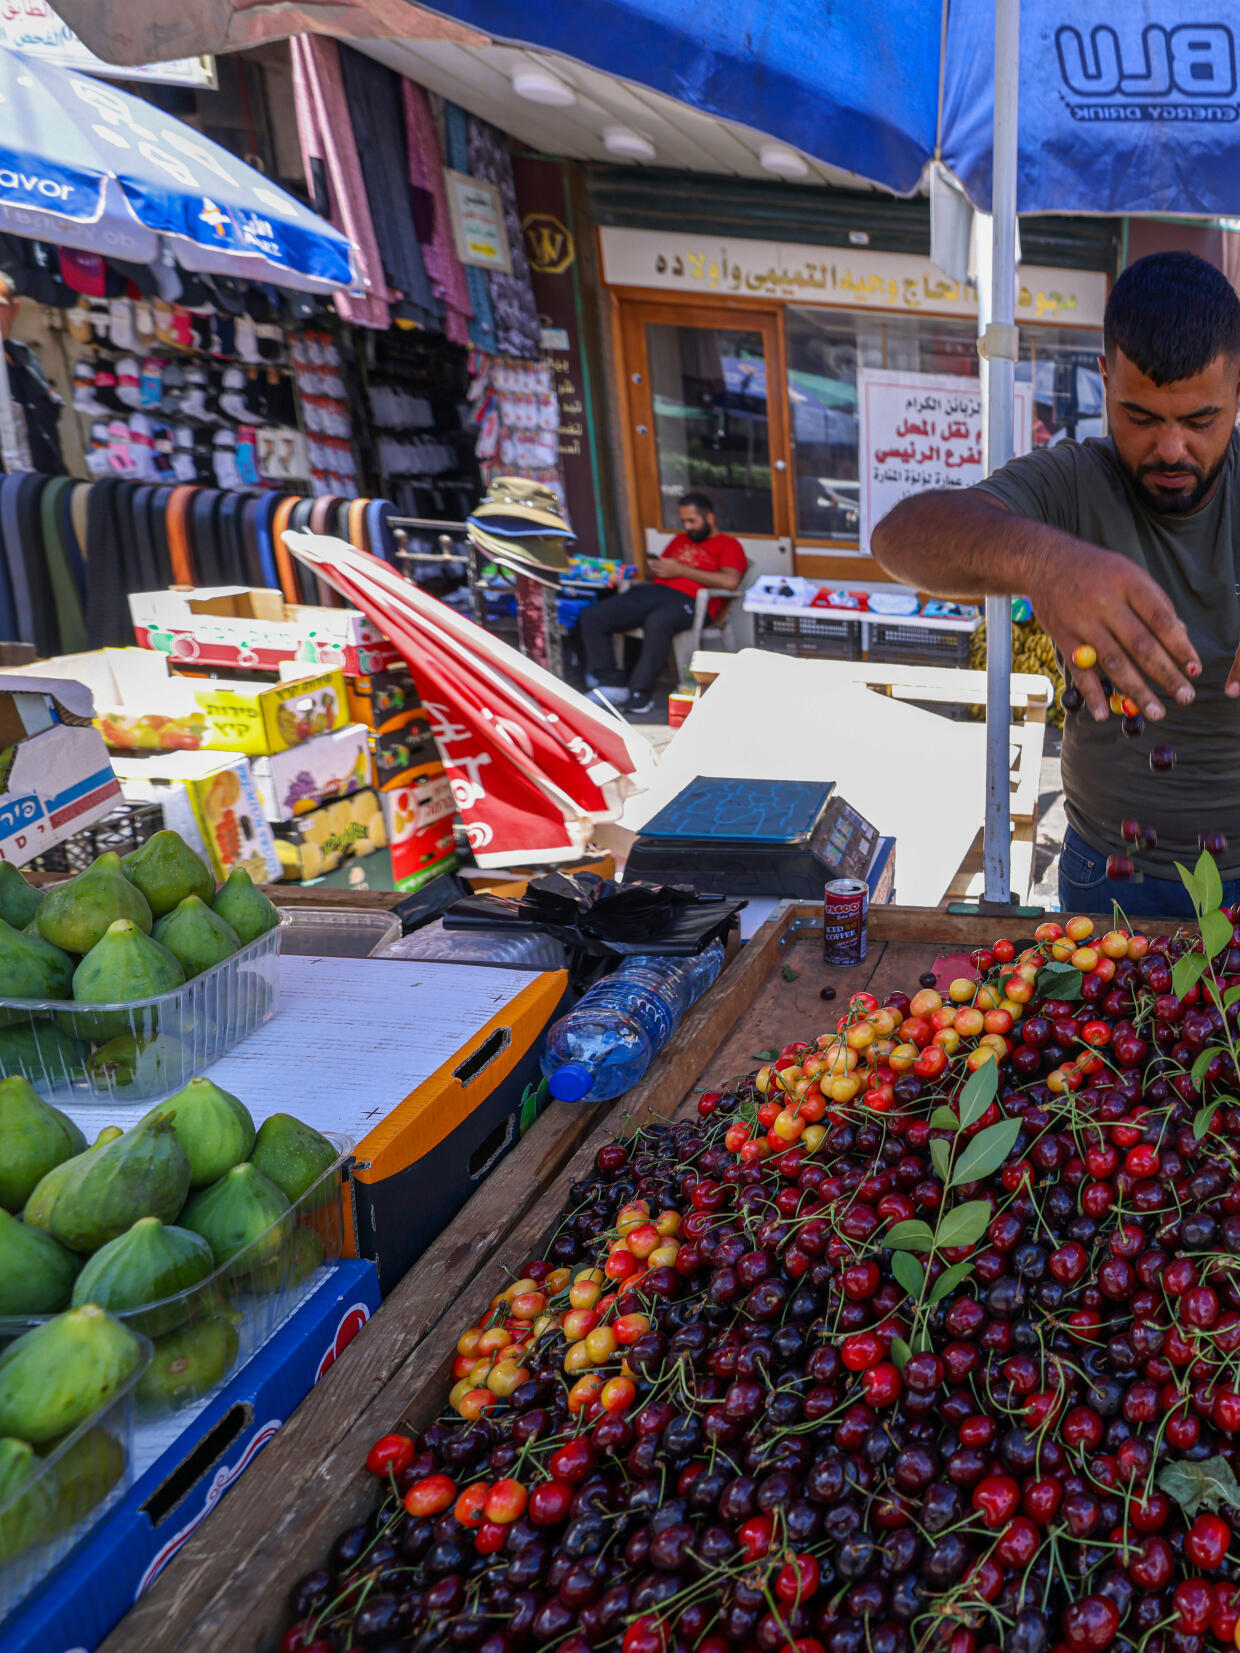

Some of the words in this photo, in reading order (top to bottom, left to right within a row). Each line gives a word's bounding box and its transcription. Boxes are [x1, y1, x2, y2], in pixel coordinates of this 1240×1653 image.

[905, 396, 941, 413] الكرام
[896, 417, 936, 437] المحل
[875, 441, 940, 465] الرئيسي
[207, 704, 259, 718] פירות
[214, 722, 250, 738] קיץ
[825, 930, 856, 941] COFFEE
